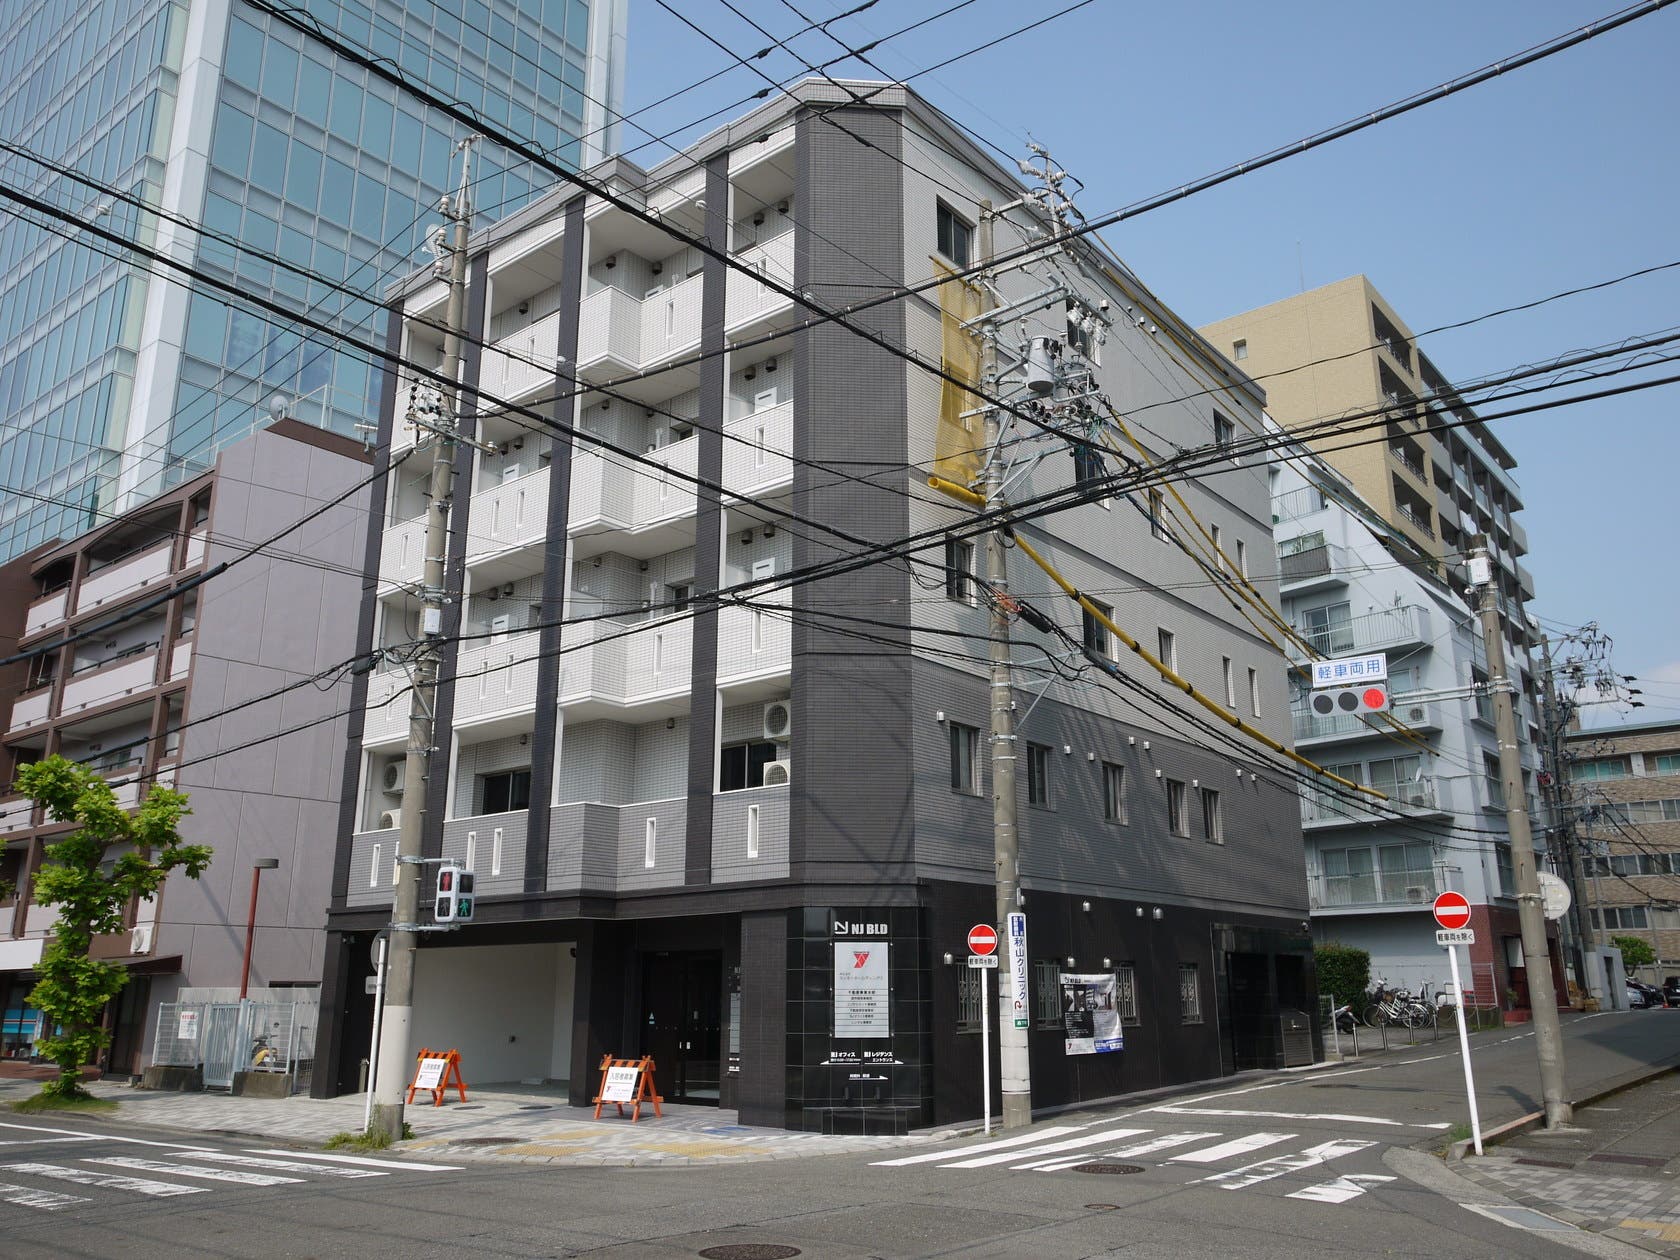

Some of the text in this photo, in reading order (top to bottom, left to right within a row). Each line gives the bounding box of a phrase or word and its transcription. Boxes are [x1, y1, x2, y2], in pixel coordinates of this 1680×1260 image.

[1317, 659, 1380, 680] 軽車両用
[866, 923, 888, 935] BLD
[1013, 937, 1026, 1000] 秋山クリニック
